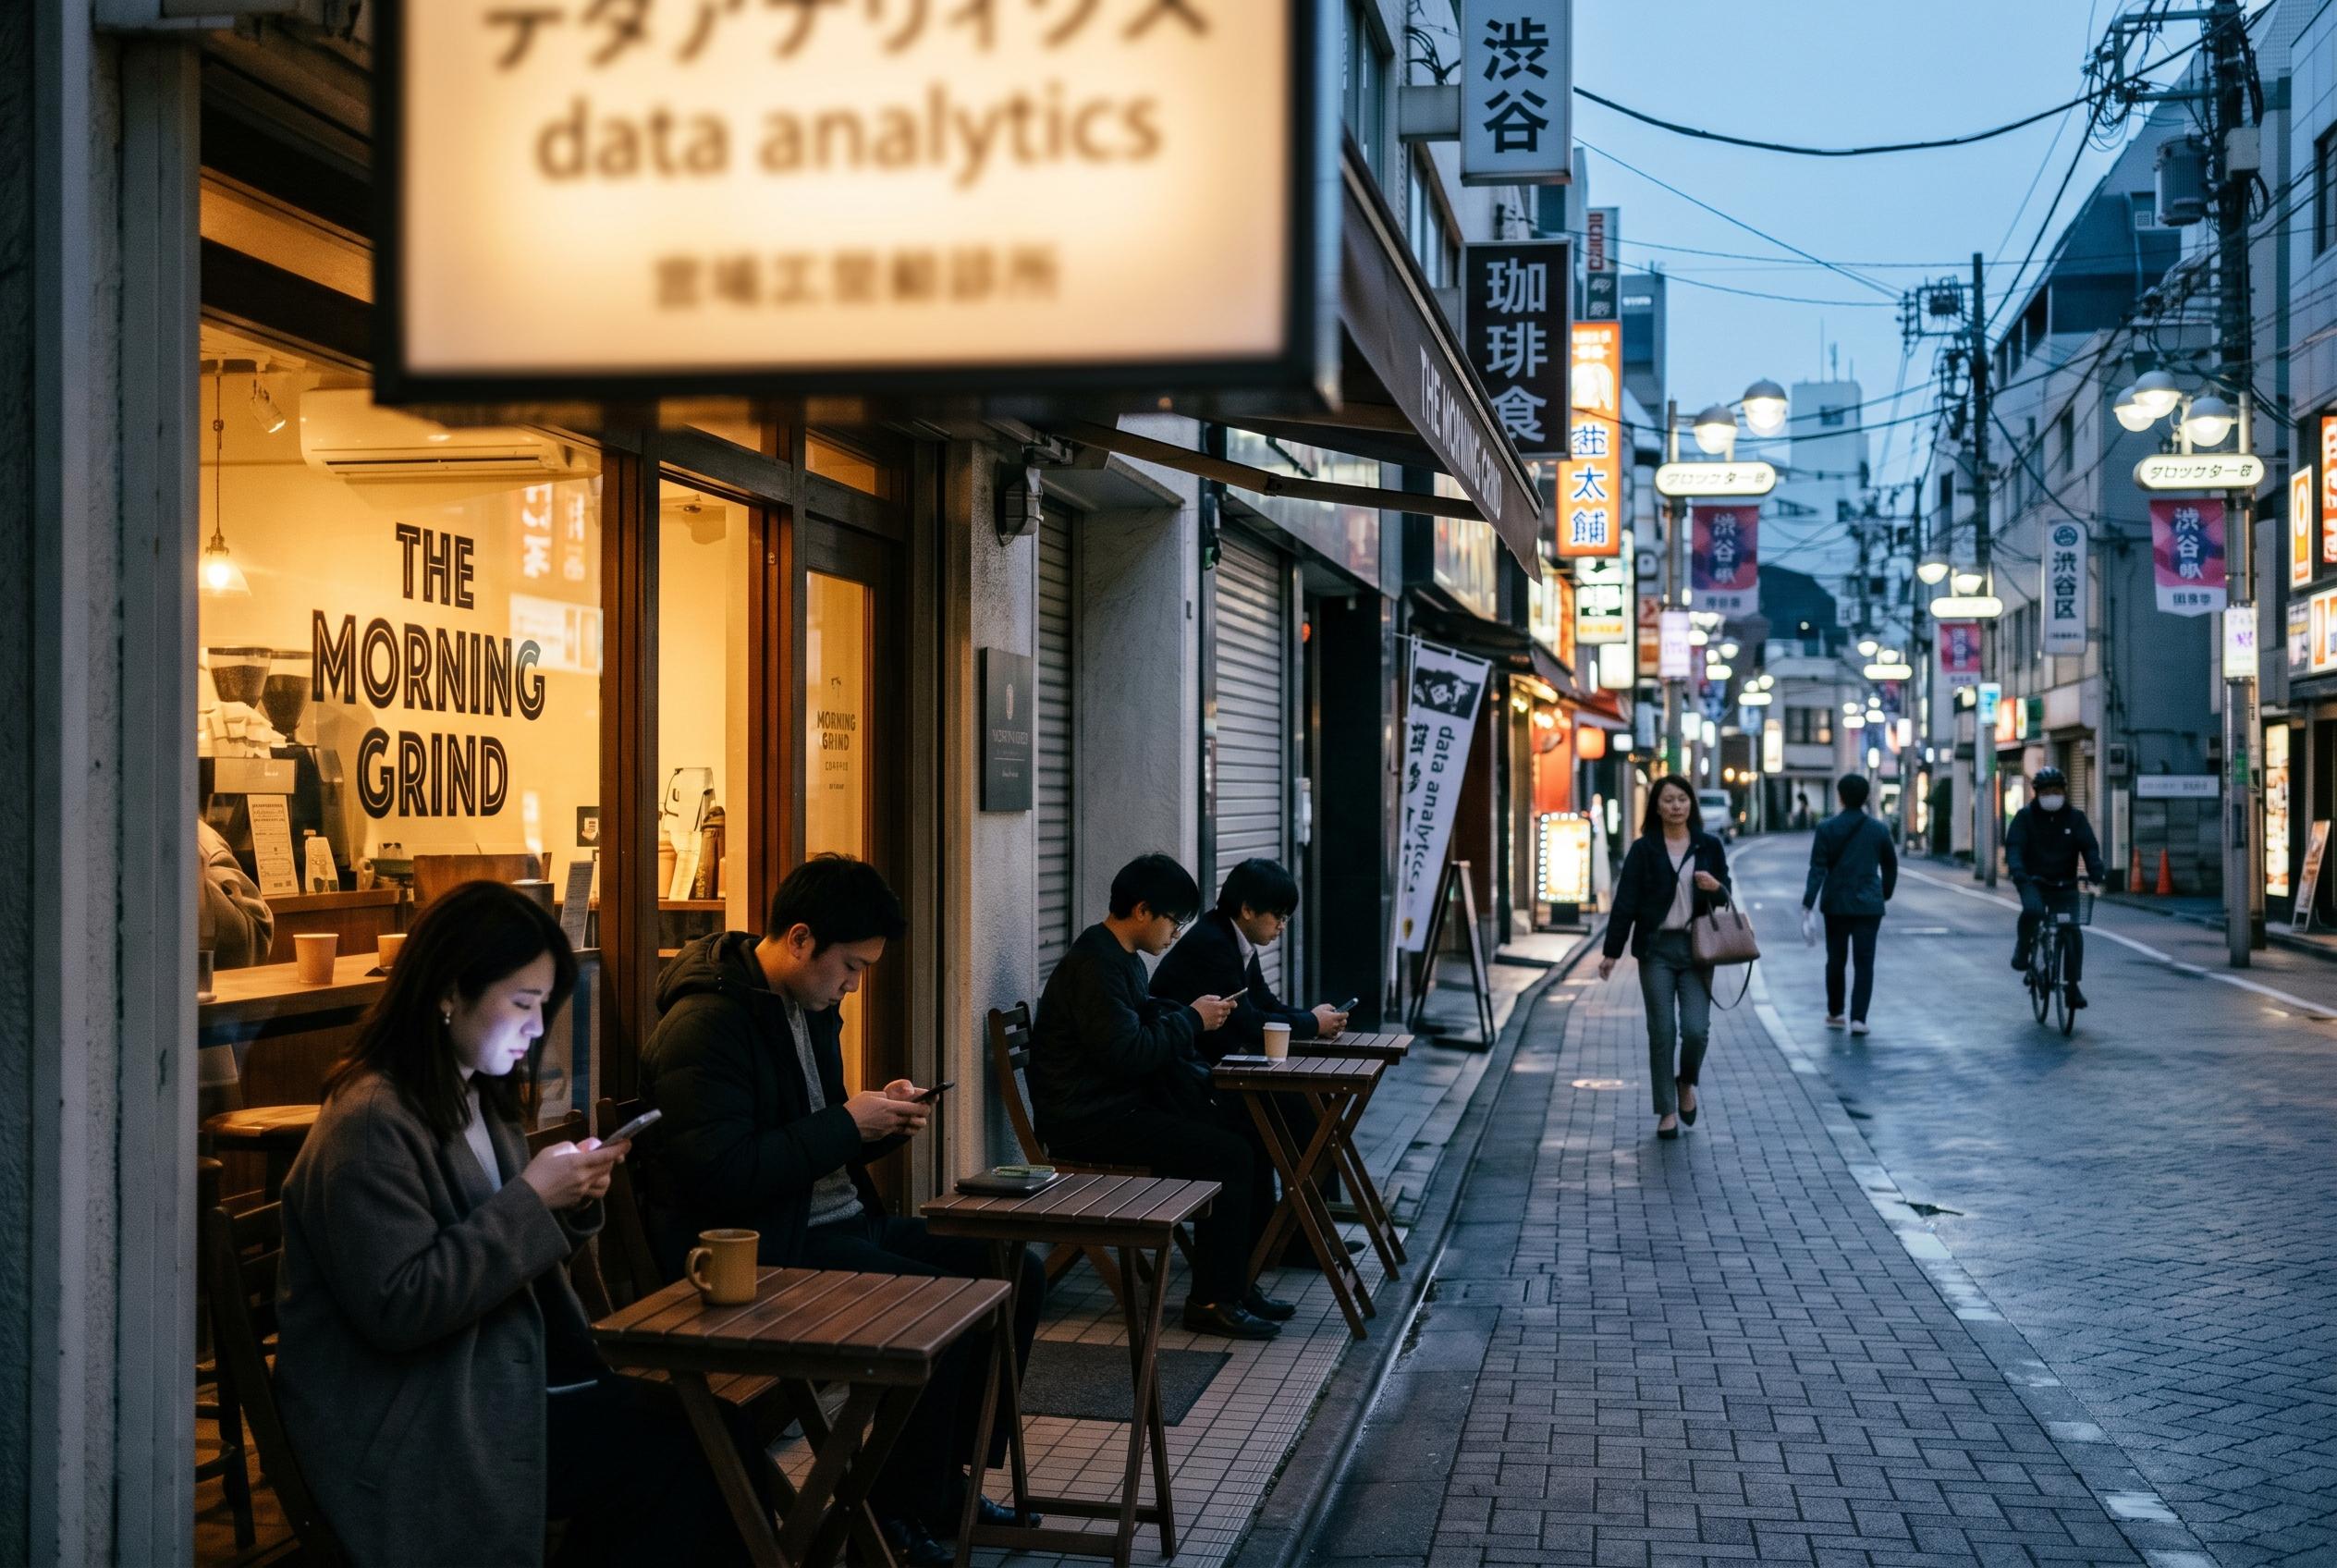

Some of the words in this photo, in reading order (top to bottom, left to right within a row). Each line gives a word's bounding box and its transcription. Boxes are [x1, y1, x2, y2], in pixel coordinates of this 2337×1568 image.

[1483, 17, 1549, 153] 渋谷
[534, 99, 730, 182] data
[758, 83, 1165, 190] analytics
[1486, 257, 1548, 443] 珈琲食
[1419, 344, 1440, 439] THE
[1442, 384, 1481, 492] MORNING
[1481, 447, 1502, 521] GRIND
[396, 521, 474, 611] THE
[312, 609, 545, 721] MORNING
[817, 710, 856, 731] MORNING
[822, 732, 850, 751] GRIND
[1431, 725, 1456, 774] data
[357, 726, 508, 819] GRIND
